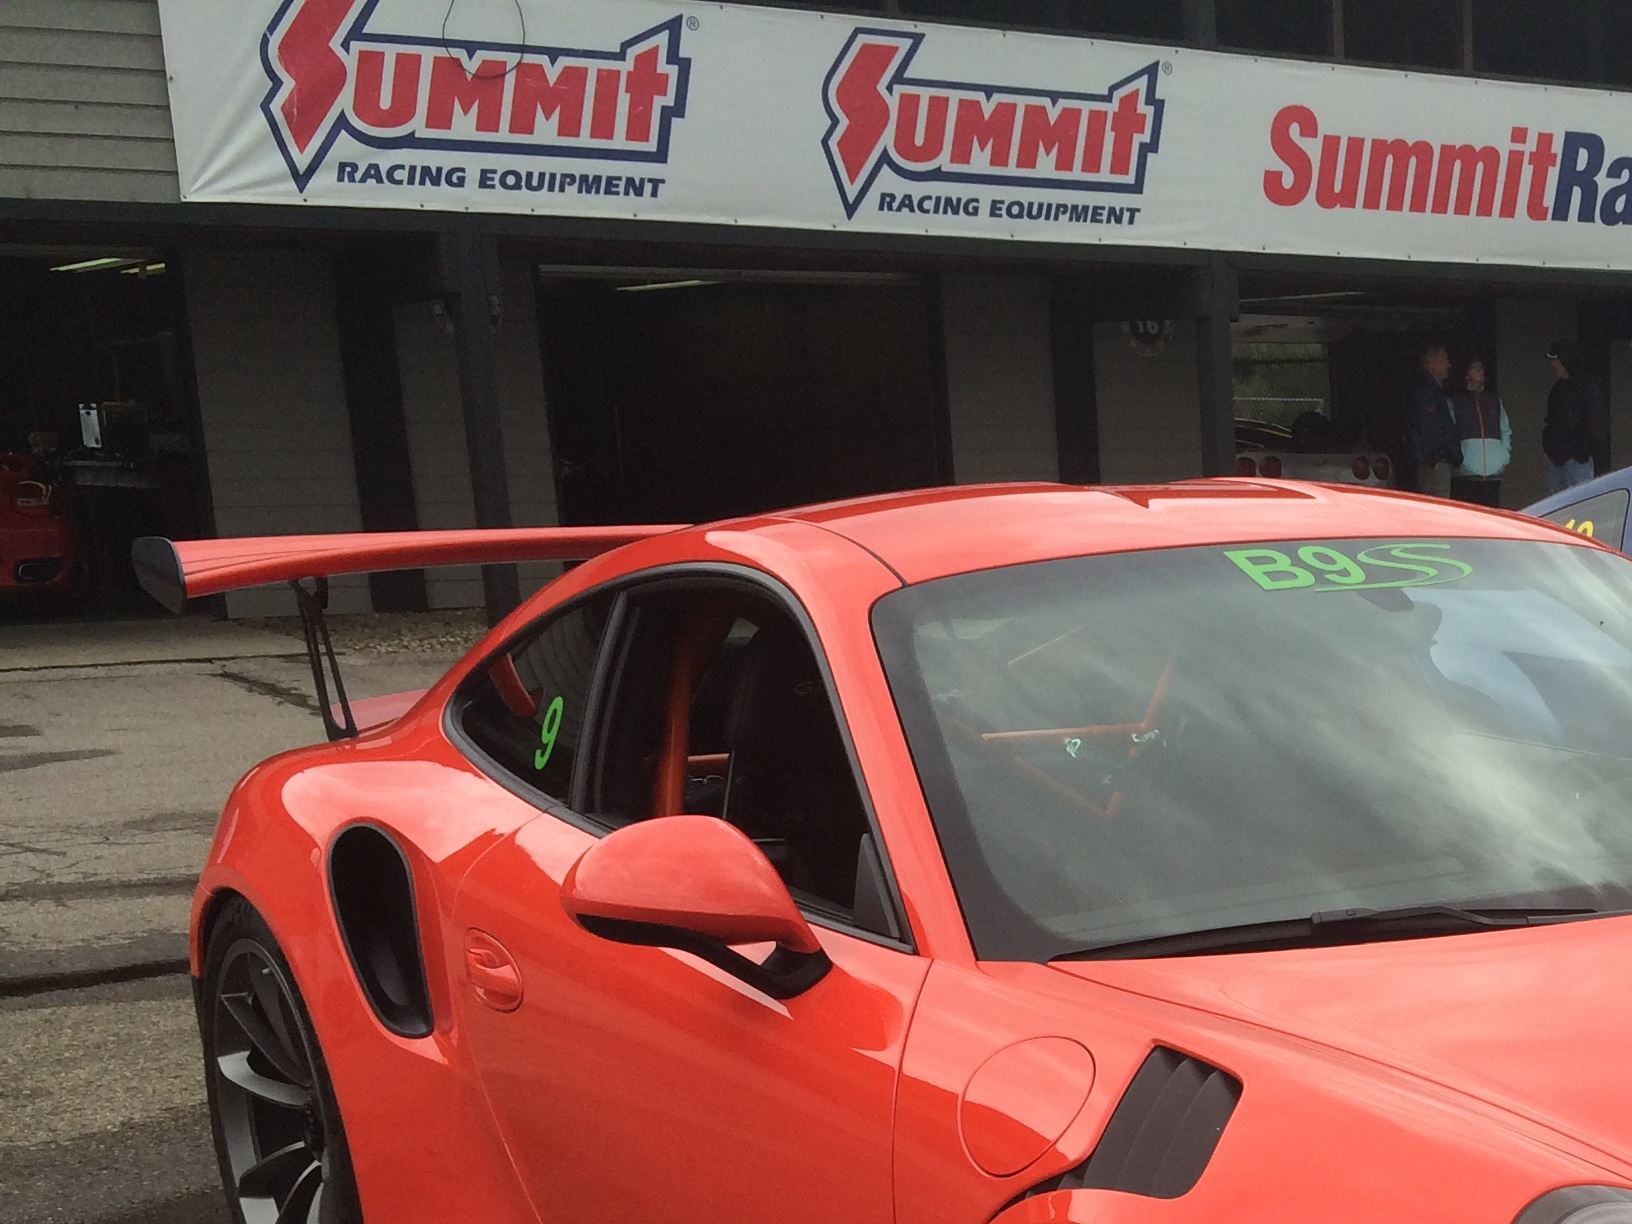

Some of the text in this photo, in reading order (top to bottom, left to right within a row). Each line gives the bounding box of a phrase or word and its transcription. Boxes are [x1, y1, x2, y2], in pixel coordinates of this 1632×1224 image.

[336, 161, 666, 198] RACING EQUIPMENT
[877, 191, 1141, 226] RACING EQUIPMENT
[534, 696, 564, 770] 9
